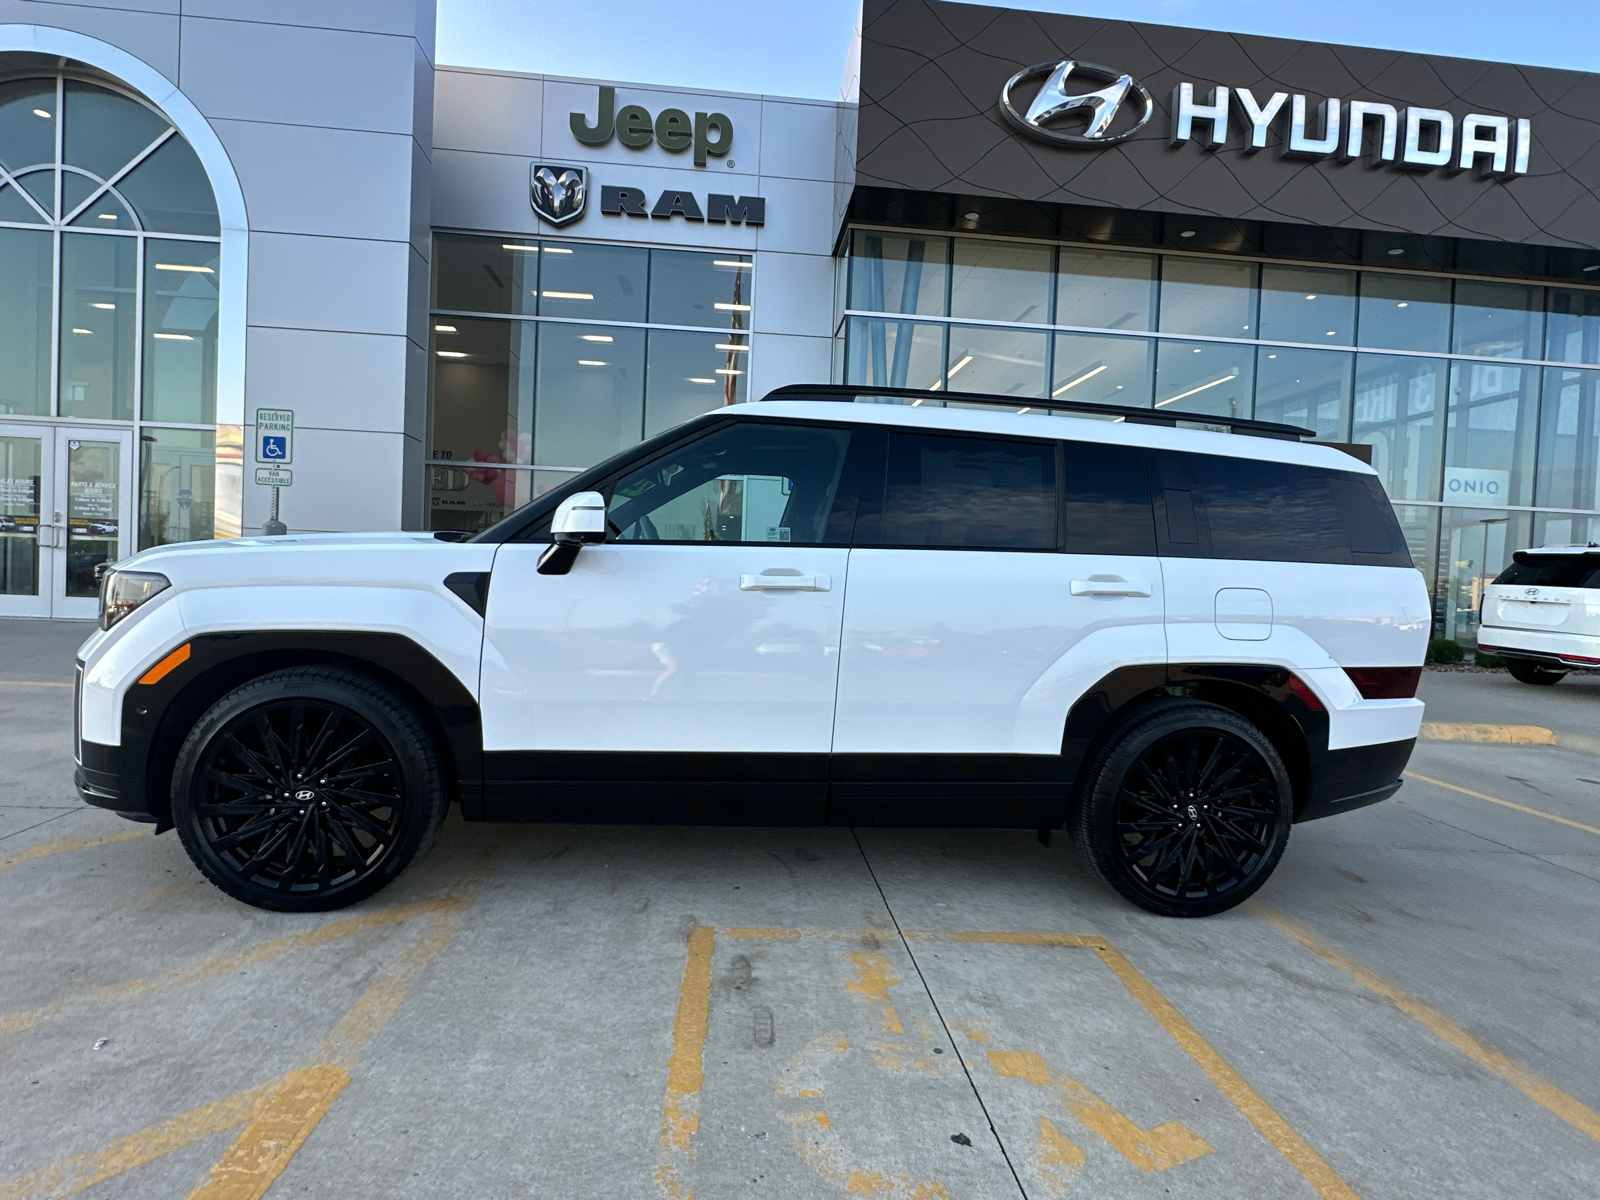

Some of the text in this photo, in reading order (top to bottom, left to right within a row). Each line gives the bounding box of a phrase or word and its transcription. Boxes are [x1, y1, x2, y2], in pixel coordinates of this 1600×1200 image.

[569, 86, 734, 167] Jeep
[1171, 81, 1531, 177] HYUNDAI
[600, 185, 766, 226] RAM
[259, 412, 291, 422] RESERVED
[259, 422, 291, 431] PARKING
[441, 451, 452, 459] TO
[257, 476, 290, 484] ACCESSIBLE
[1448, 478, 1499, 494] ONIQ
